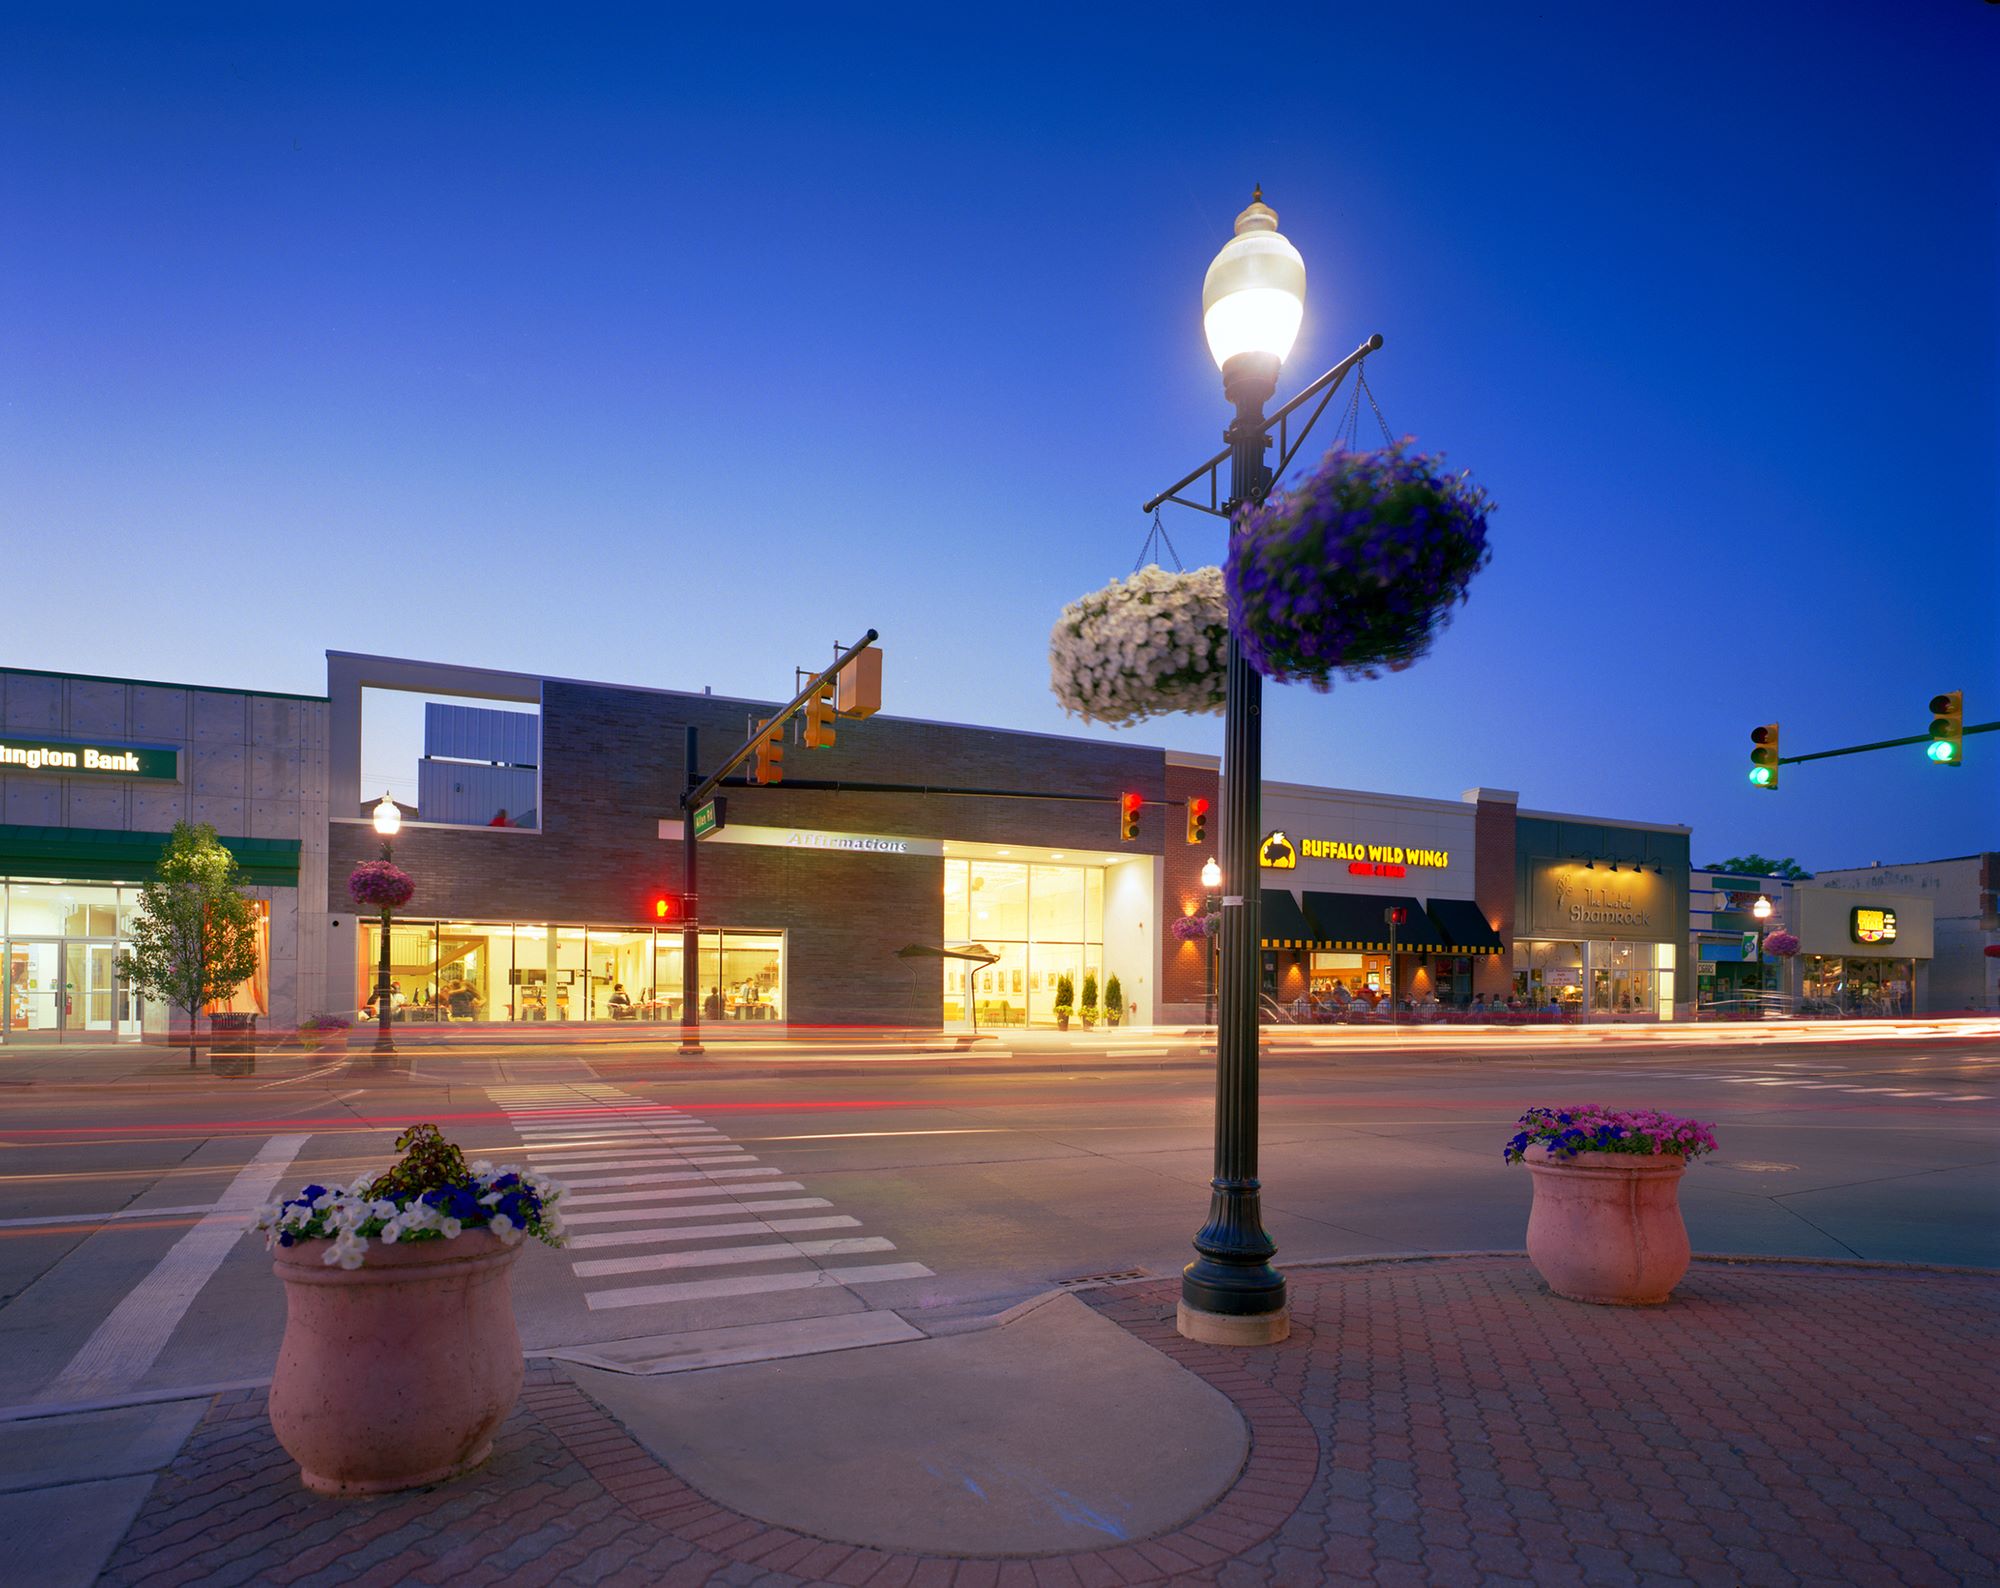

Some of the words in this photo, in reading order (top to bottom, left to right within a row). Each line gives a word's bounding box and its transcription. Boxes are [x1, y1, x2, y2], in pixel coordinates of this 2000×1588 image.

[83, 748, 140, 772] Bank
[786, 832, 908, 852] Affirmations
[1301, 839, 1366, 861] BUFFALO
[1368, 844, 1404, 864] WILD
[1405, 847, 1449, 868] WINGS
[1585, 887, 1601, 907] The
[1601, 888, 1632, 910] Twisted
[1569, 903, 1651, 927] Shamrock
